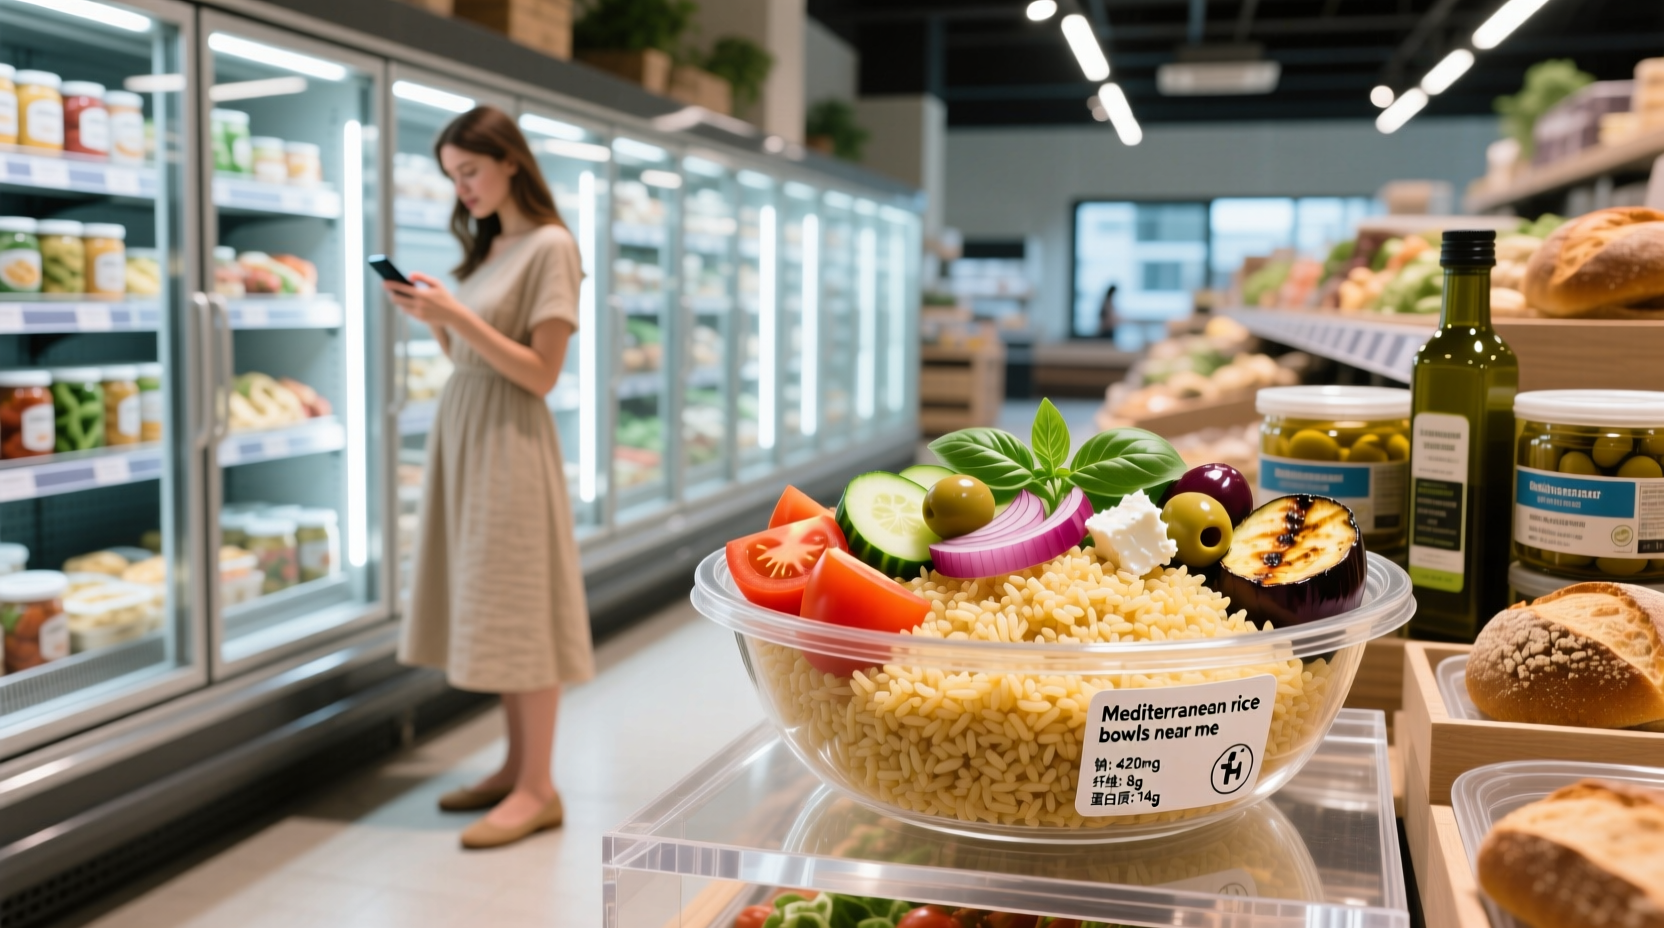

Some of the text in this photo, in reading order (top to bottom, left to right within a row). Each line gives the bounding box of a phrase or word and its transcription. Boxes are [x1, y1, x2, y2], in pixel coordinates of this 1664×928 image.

[1101, 695, 1261, 722] Mediterranean rice
[1098, 723, 1220, 743] bowls near me
[1115, 757, 1161, 773] 420mg
[1126, 774, 1143, 791] 8g
[1138, 790, 1160, 808] 14g
